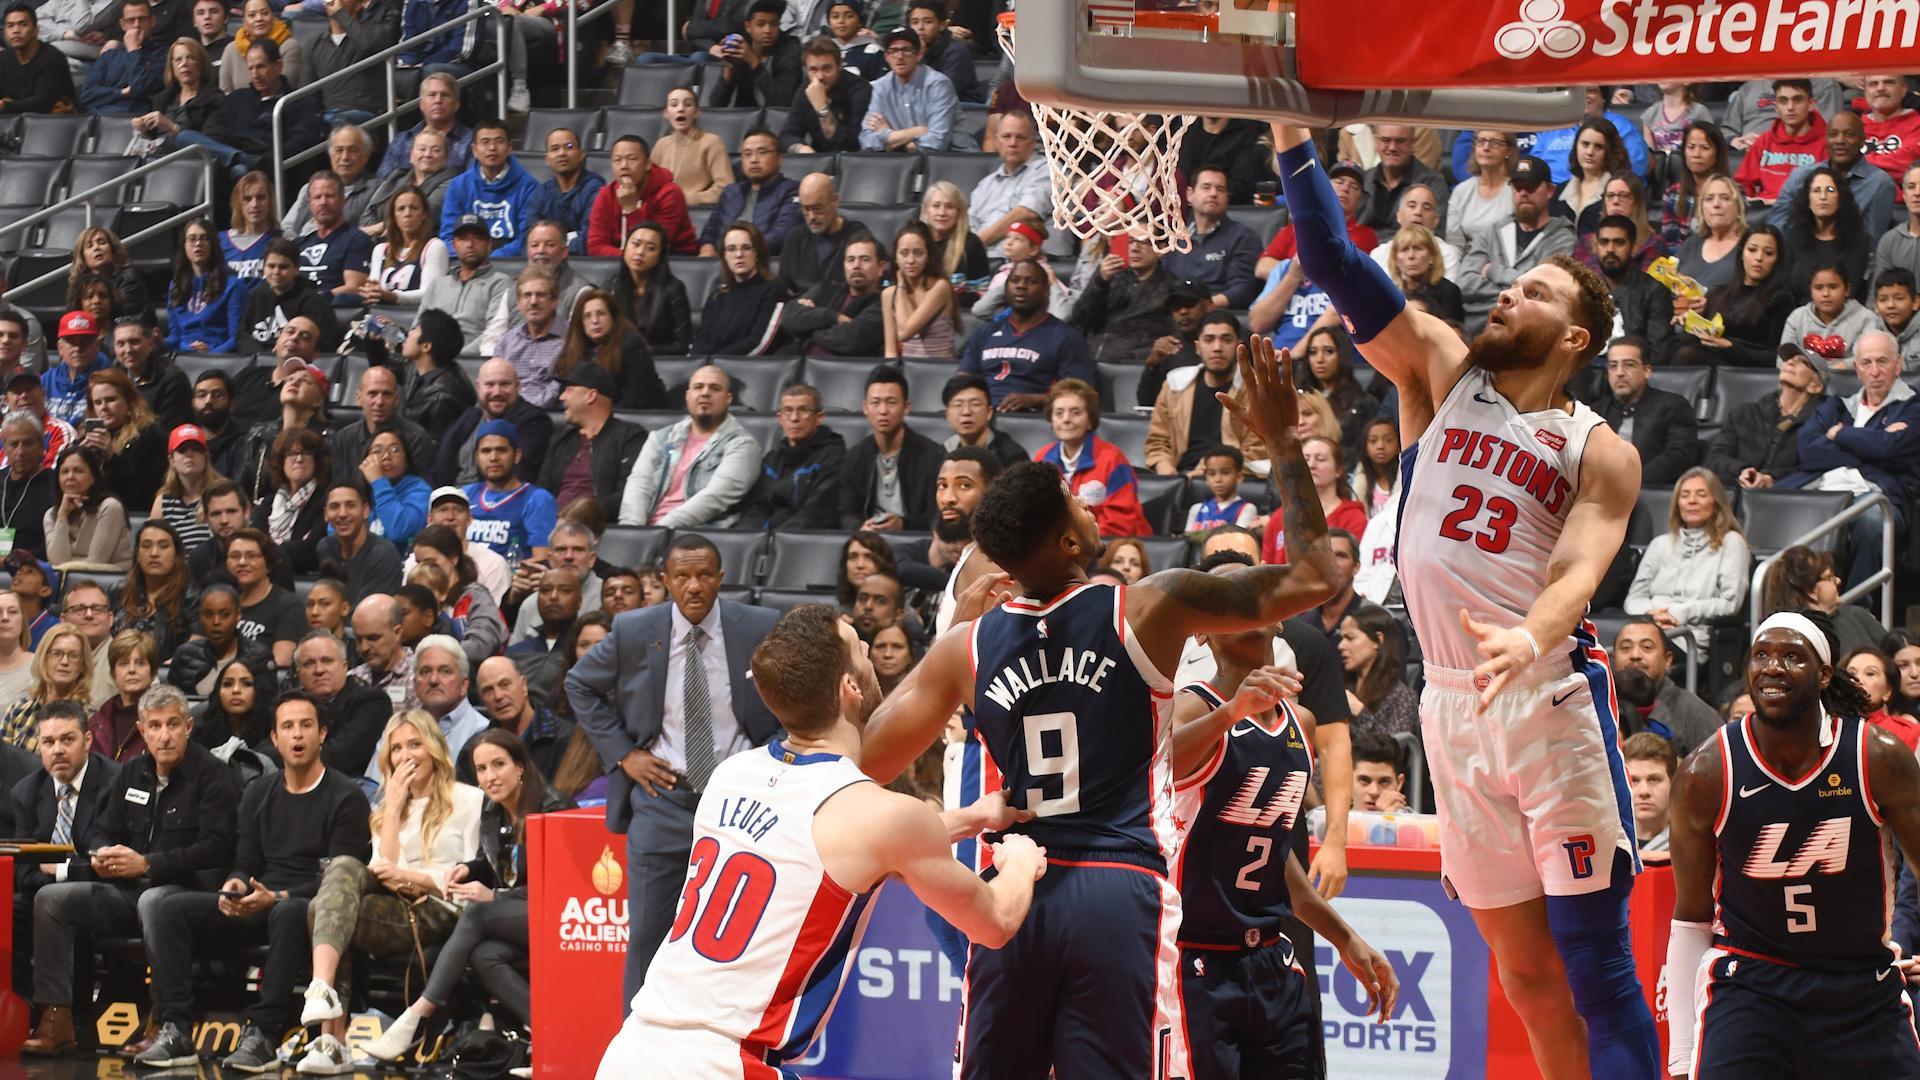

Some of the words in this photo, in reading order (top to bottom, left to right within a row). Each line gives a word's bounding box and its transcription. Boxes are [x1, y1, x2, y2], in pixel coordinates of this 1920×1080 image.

[490, 219, 505, 239] 6
[1437, 428, 1572, 515] PISTONS
[466, 520, 511, 544] PPERS
[1439, 484, 1518, 555] 23
[985, 647, 1117, 711] WALLACE
[1023, 711, 1081, 818] 9
[1217, 766, 1308, 831] LA
[1817, 786, 1852, 798] bumble
[719, 797, 779, 843] LEUER
[1235, 835, 1273, 891] 2
[1741, 816, 1852, 880] LA
[560, 897, 629, 925] AGU
[668, 836, 777, 963] 30
[1783, 884, 1817, 934] 5
[560, 923, 630, 942] CALIEN
[560, 941, 602, 952] CASINO
[607, 943, 628, 953] RES
[1315, 946, 1436, 1022] FOX
[1323, 1021, 1437, 1052] PORTS
